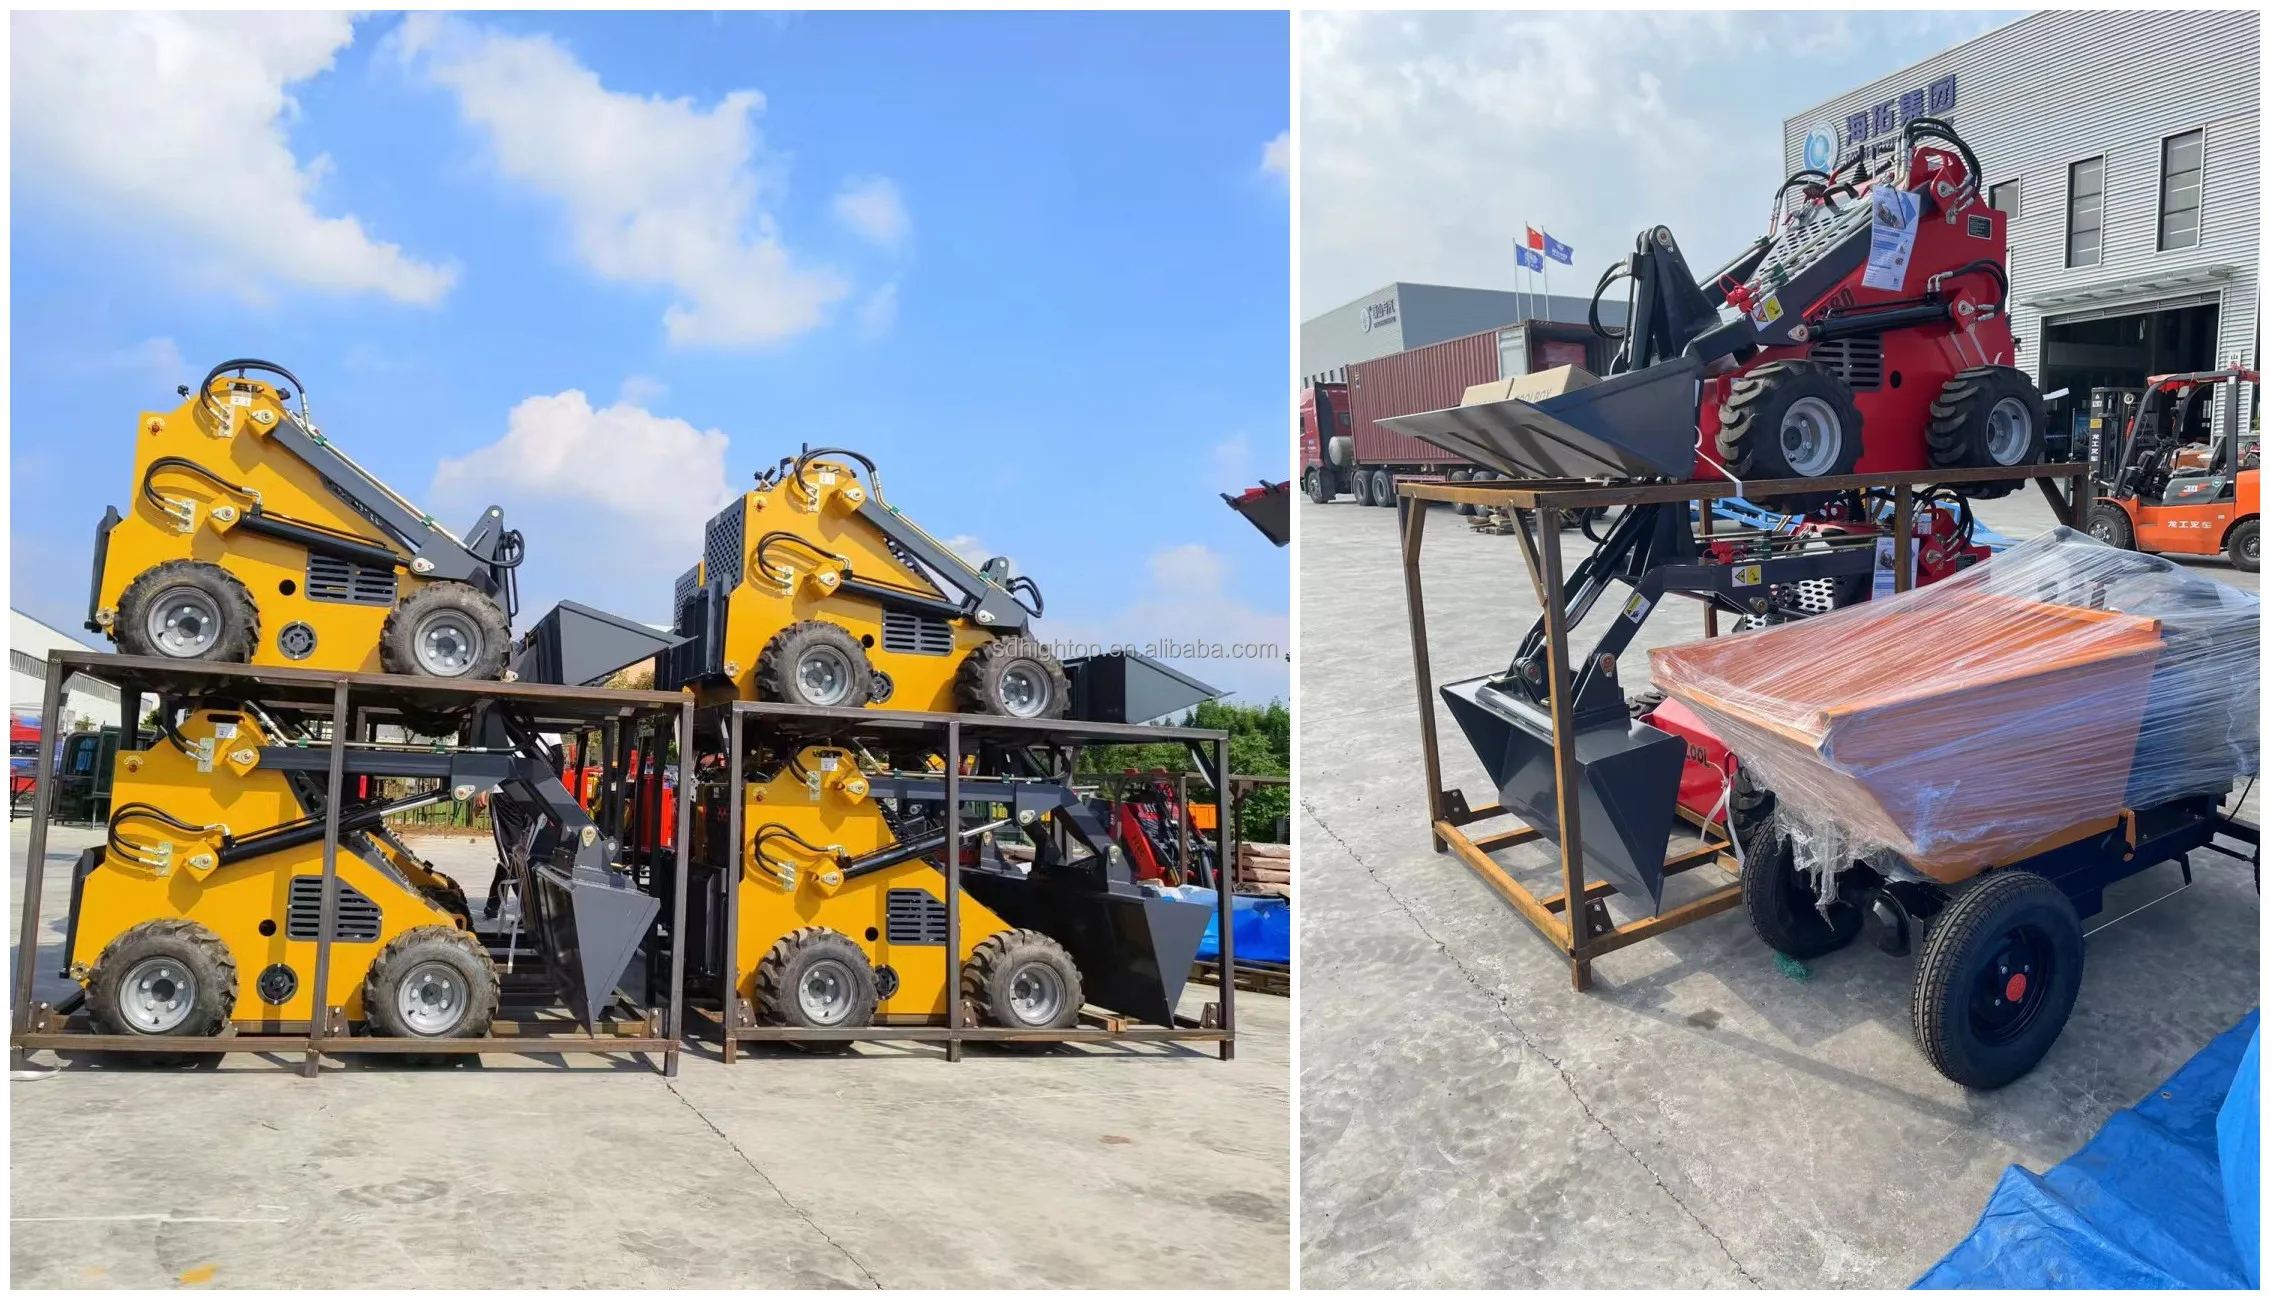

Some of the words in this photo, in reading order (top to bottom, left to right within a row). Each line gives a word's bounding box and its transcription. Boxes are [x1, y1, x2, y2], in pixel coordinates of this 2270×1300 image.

[1845, 74, 1956, 145] 海拓集团
[2183, 485, 2198, 493] 30
[2167, 520, 2212, 529] 龙工叉车
